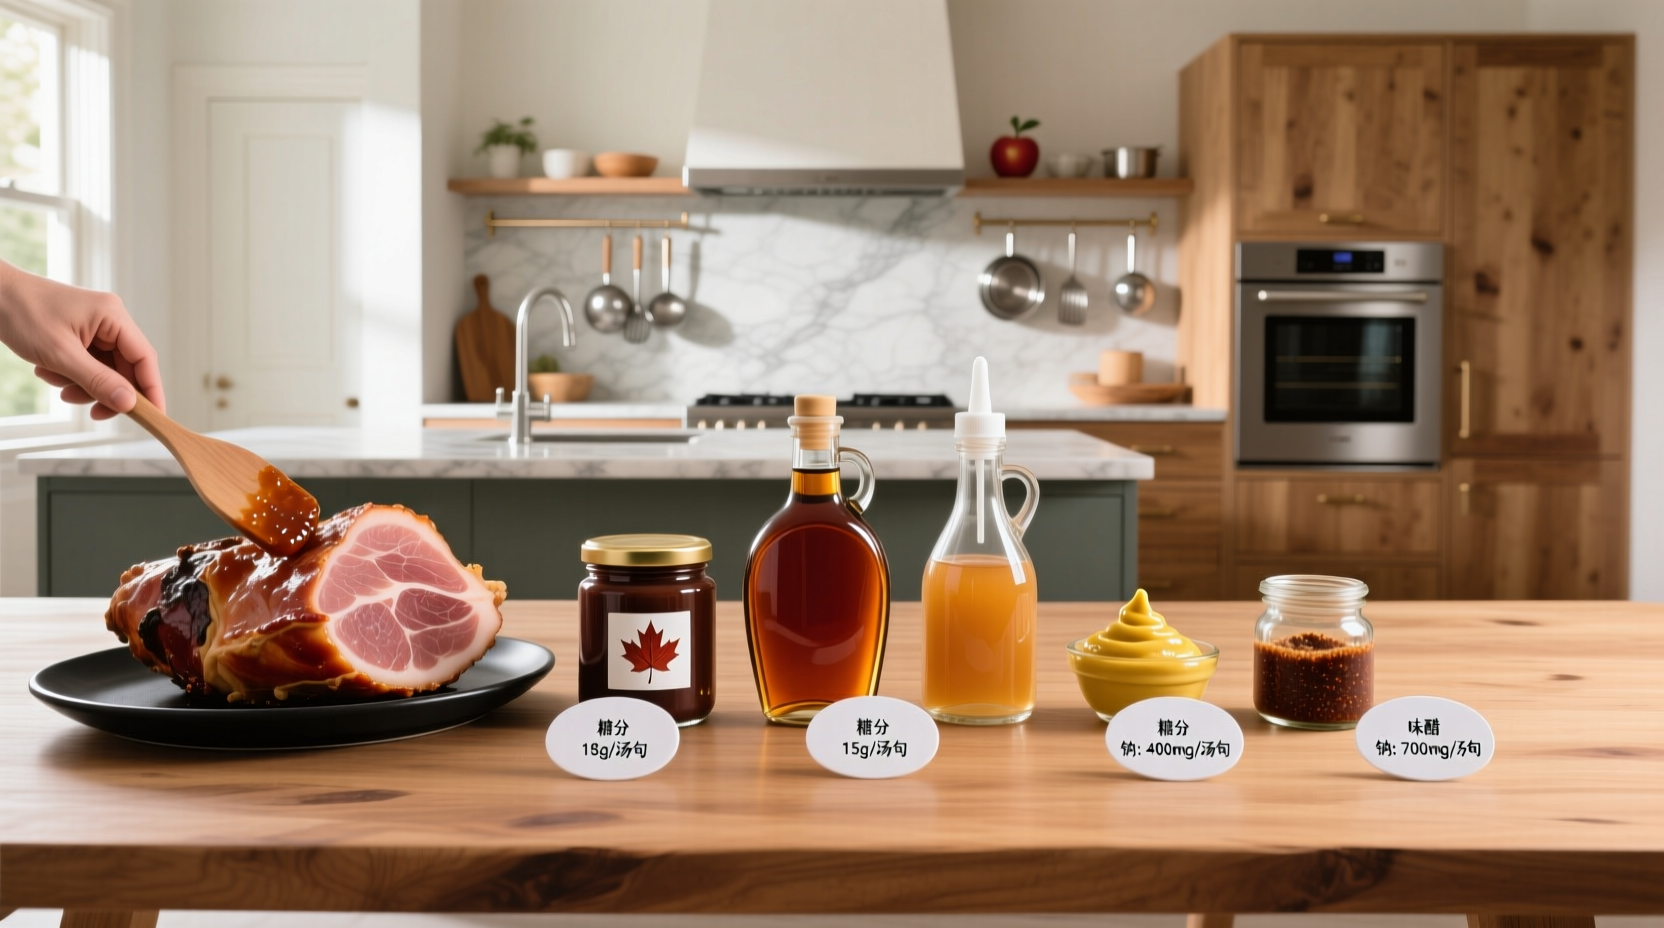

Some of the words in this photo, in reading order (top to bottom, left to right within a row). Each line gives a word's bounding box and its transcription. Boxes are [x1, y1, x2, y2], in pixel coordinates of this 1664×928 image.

[597, 718, 629, 737] 糖分
[856, 717, 890, 736] 糖分
[1157, 718, 1190, 737] 糖分
